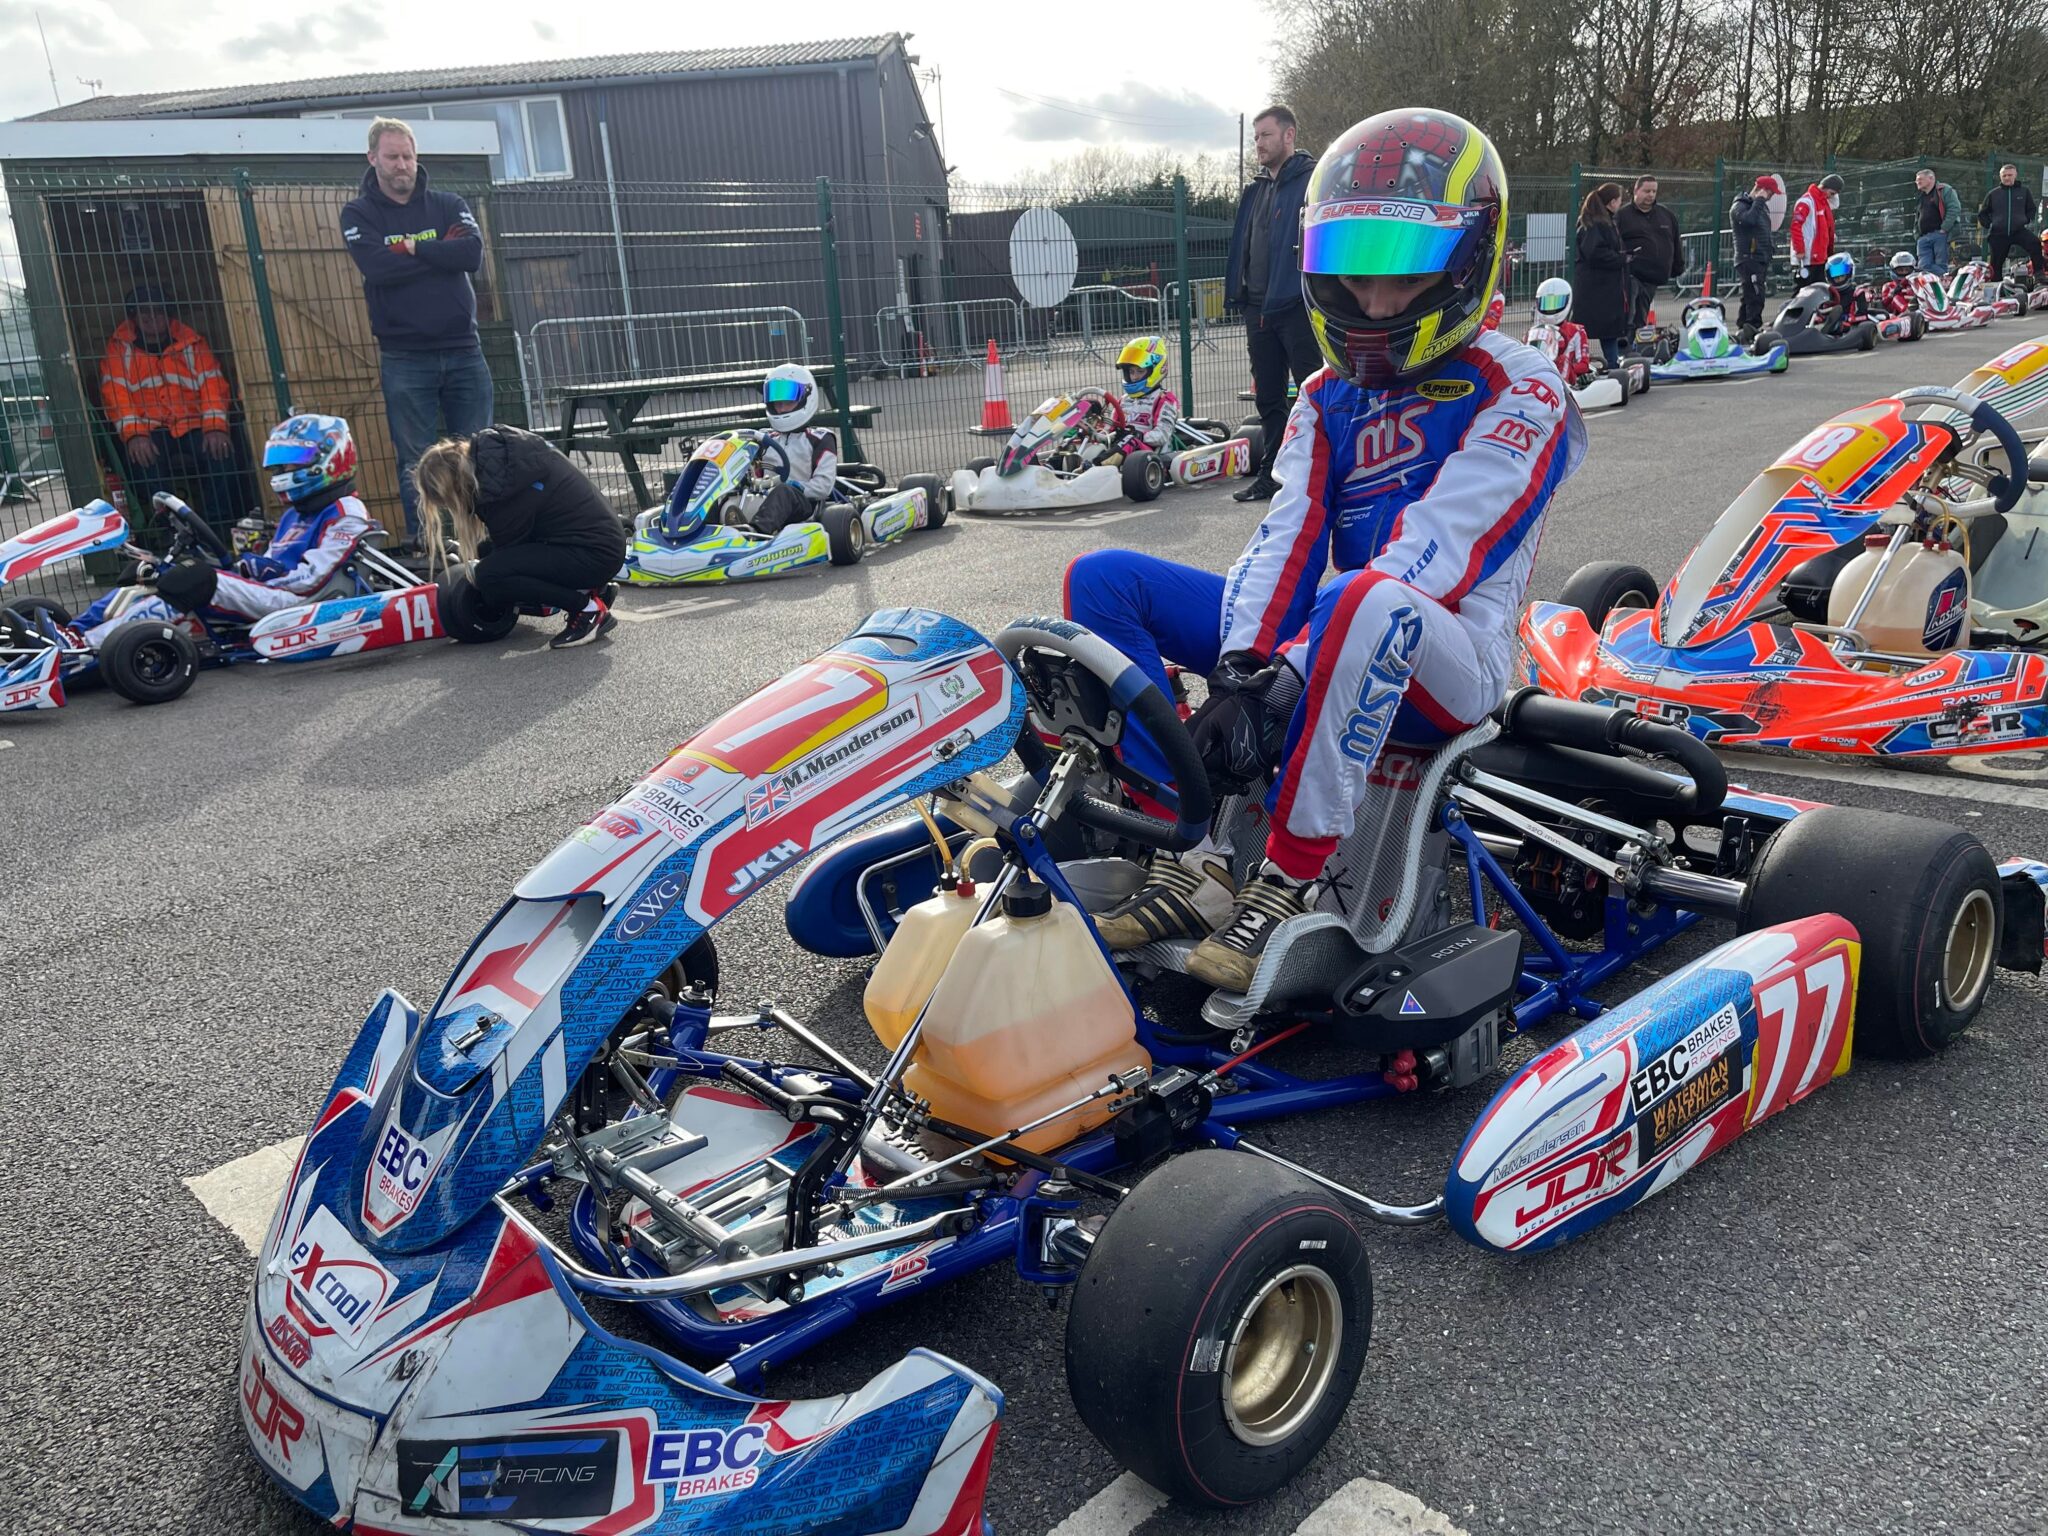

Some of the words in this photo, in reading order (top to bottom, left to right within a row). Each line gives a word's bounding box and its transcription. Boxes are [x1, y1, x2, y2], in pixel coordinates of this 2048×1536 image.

[1320, 202, 1425, 220] SUPERONE
[1234, 444, 1250, 471] 38
[746, 544, 805, 570] Evolution
[269, 627, 318, 651] JDR
[395, 593, 435, 643] 14
[5, 686, 41, 707] JDR
[782, 708, 915, 791] M.Manderson
[629, 801, 689, 841] RACING
[643, 788, 704, 829] BRAKES
[725, 838, 804, 896] JKH
[623, 879, 680, 936] CWG
[1431, 937, 1478, 959] ROTAX
[1690, 1028, 1737, 1067] RACING
[1750, 953, 1845, 1124] 77
[1630, 1043, 1690, 1115] EBC
[1687, 1009, 1734, 1052] BRAKES
[1653, 1056, 1729, 1125] WATERMAN
[1654, 1074, 1730, 1140] GRAPHICS
[377, 1124, 428, 1191] EBC
[1493, 1119, 1586, 1185] M.Manderson
[379, 1174, 413, 1212] BRAKES
[1515, 1130, 1632, 1228] JDR
[504, 1464, 597, 1485] RACING
[647, 1424, 766, 1481] EBC
[676, 1468, 756, 1498] BRAKES
